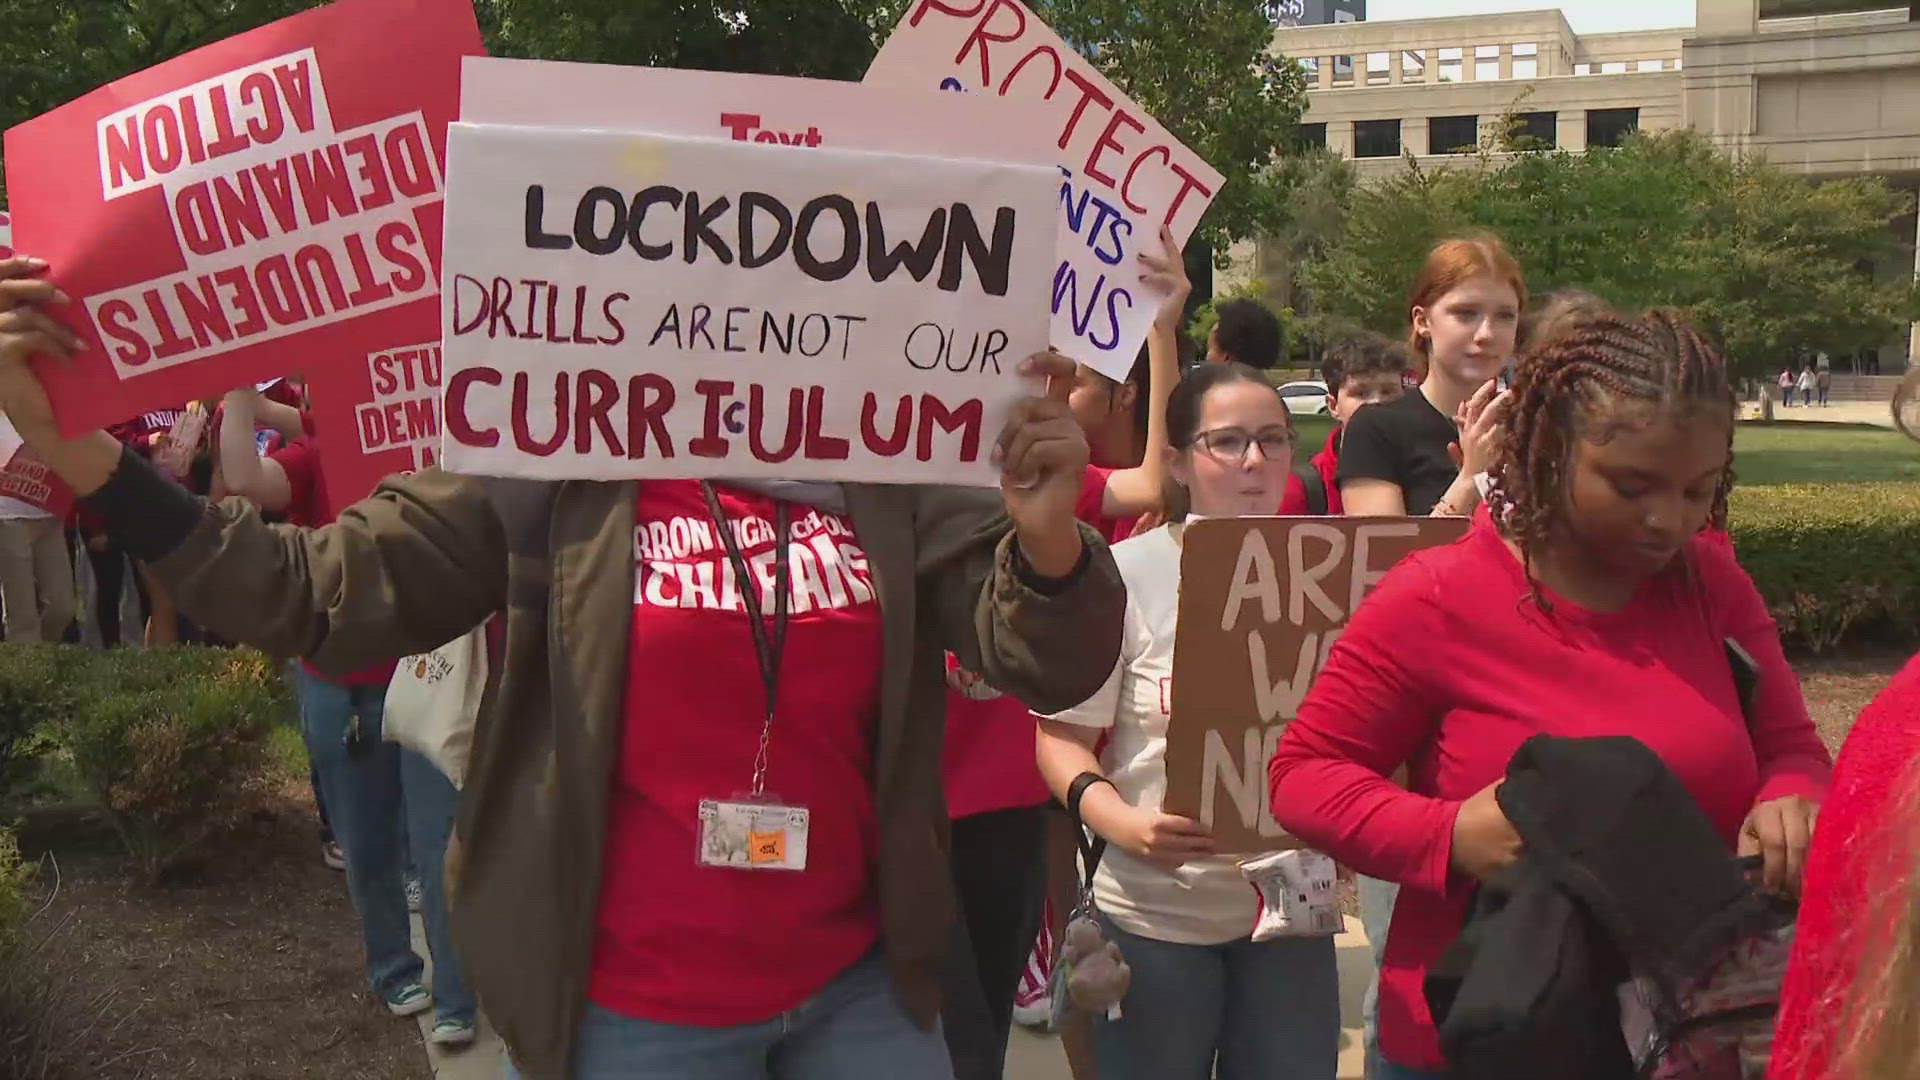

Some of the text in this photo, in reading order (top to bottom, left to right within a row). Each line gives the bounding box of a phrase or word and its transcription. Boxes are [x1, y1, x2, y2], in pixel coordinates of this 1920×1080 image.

[105, 58, 315, 188] ACTION
[175, 121, 437, 256] DEMAND
[525, 184, 1016, 296] LOCKDOWN
[97, 221, 427, 367] STUDENTS
[452, 273, 630, 345] DRILLS
[904, 322, 1009, 374] OUR
